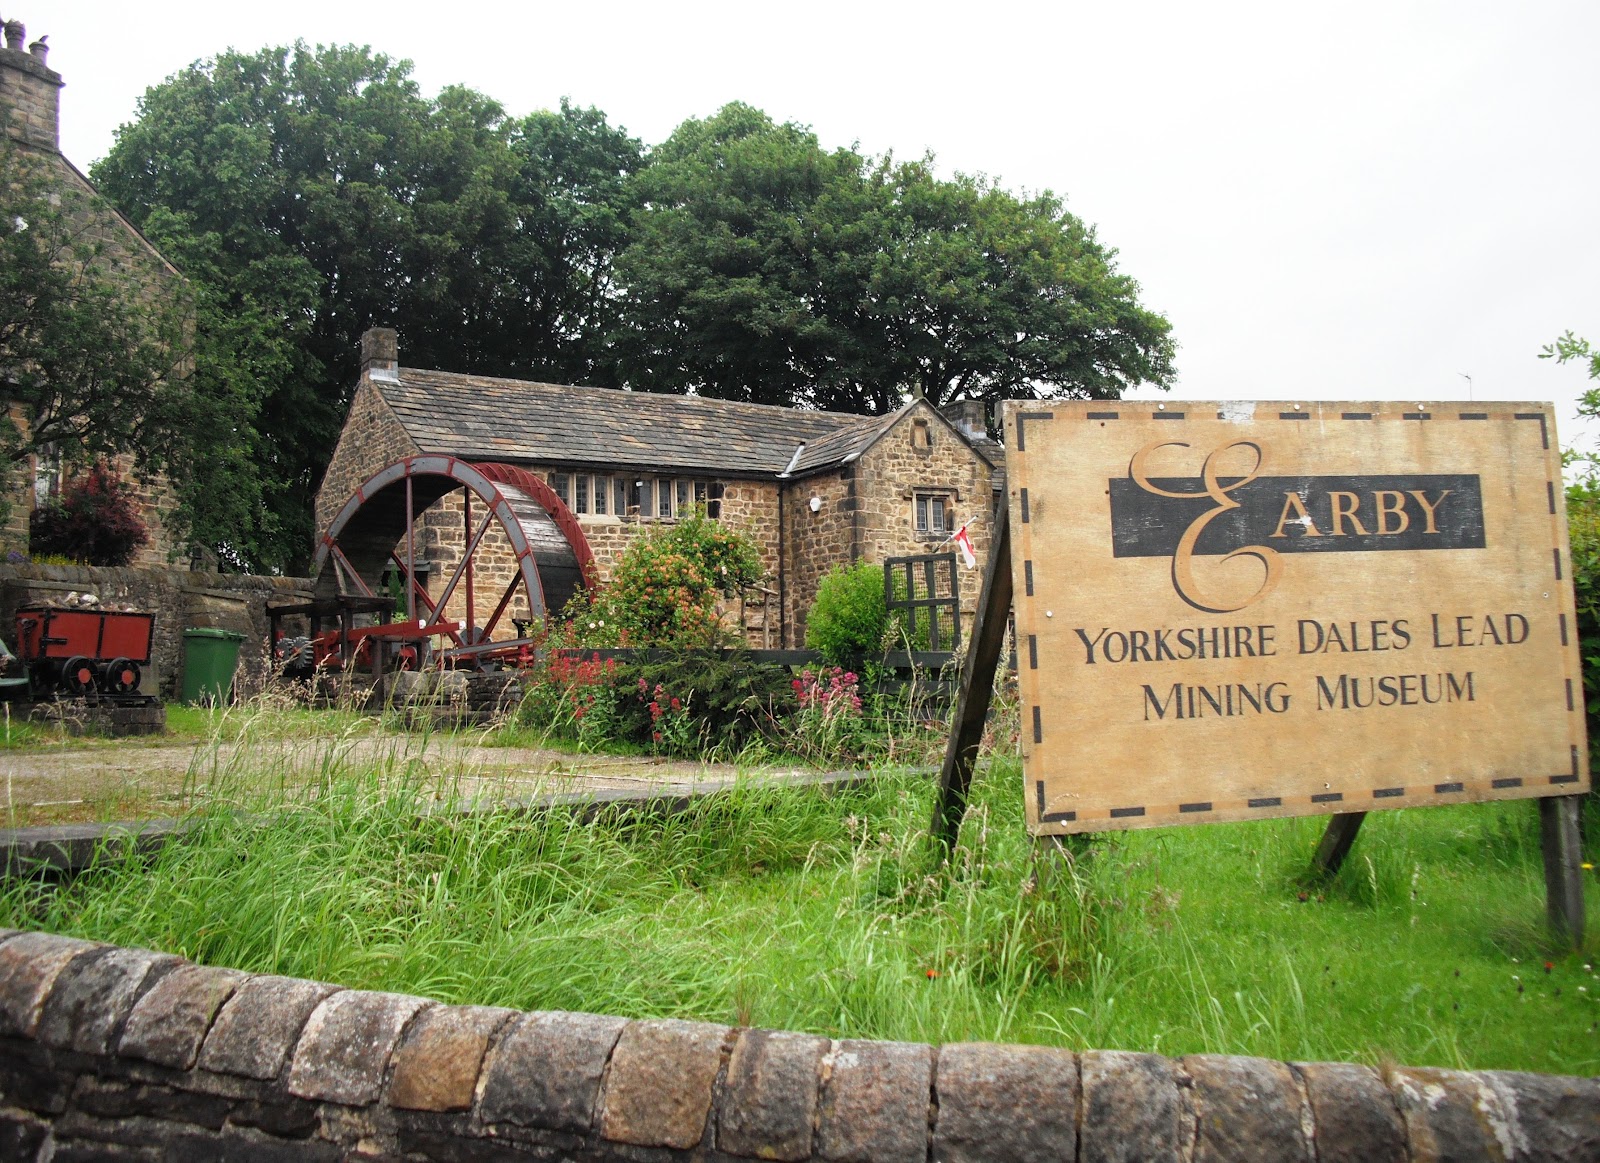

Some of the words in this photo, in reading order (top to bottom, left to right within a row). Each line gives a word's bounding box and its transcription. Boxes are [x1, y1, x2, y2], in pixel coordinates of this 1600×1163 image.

[1128, 441, 1454, 613] EARBY
[1073, 624, 1276, 664] YORKSHIRE
[1297, 619, 1411, 654] DALES
[1431, 612, 1530, 648] LEAD
[1141, 681, 1291, 720] MINING
[1315, 671, 1476, 711] MUSEUM
